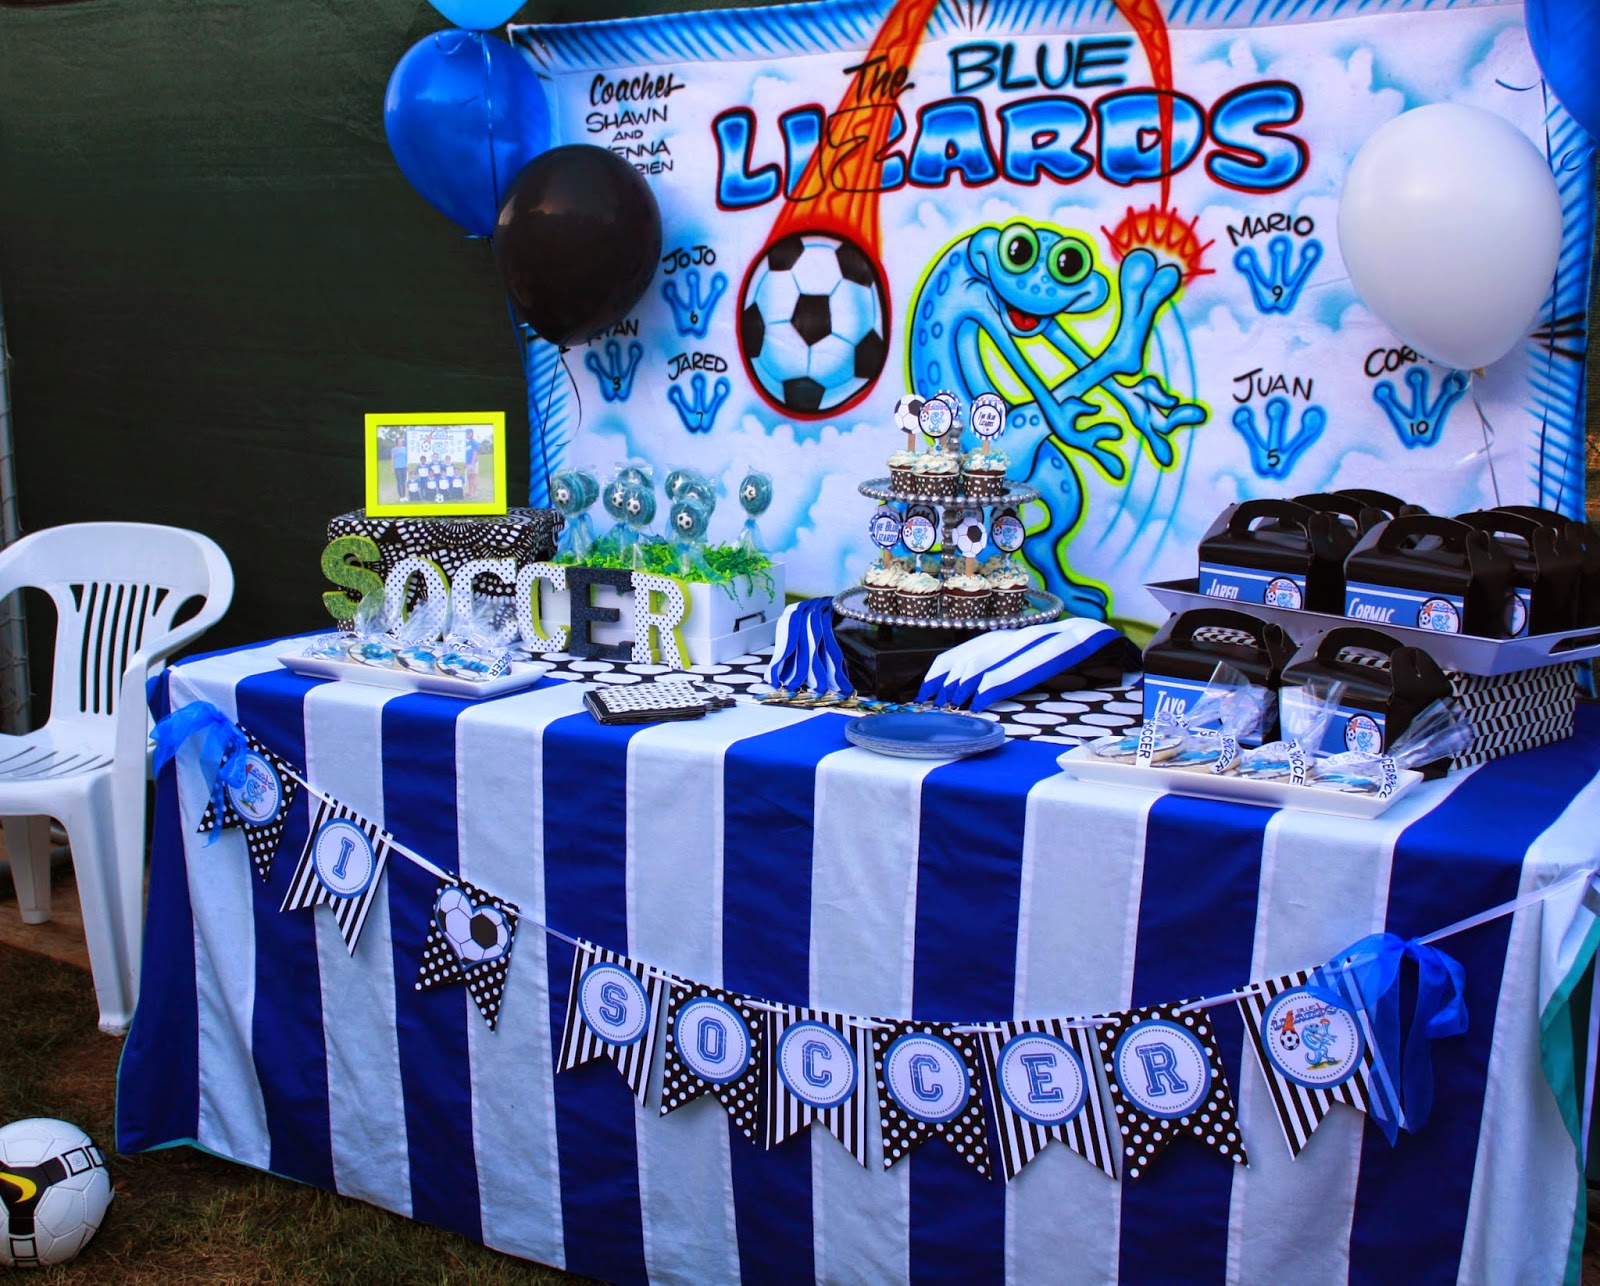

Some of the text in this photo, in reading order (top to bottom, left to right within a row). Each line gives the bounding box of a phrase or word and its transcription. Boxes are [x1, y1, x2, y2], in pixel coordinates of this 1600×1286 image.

[843, 37, 1134, 101] The BLUE
[590, 73, 686, 106] Coaches
[586, 104, 668, 133] SHAWN
[609, 139, 671, 159] ENNA
[612, 130, 644, 142] AND
[711, 80, 1309, 211] LIZARDS
[1226, 213, 1315, 246] MARIO
[1271, 285, 1283, 302] 9
[690, 310, 699, 325] 6
[667, 352, 728, 381] JARED
[612, 377, 622, 391] 3
[1232, 367, 1313, 403] JUAN
[695, 411, 704, 423] 7
[1409, 420, 1429, 436] 10
[1266, 448, 1281, 468] 5
[321, 536, 692, 671] SOCCER
[1347, 597, 1396, 624] CORMAC
